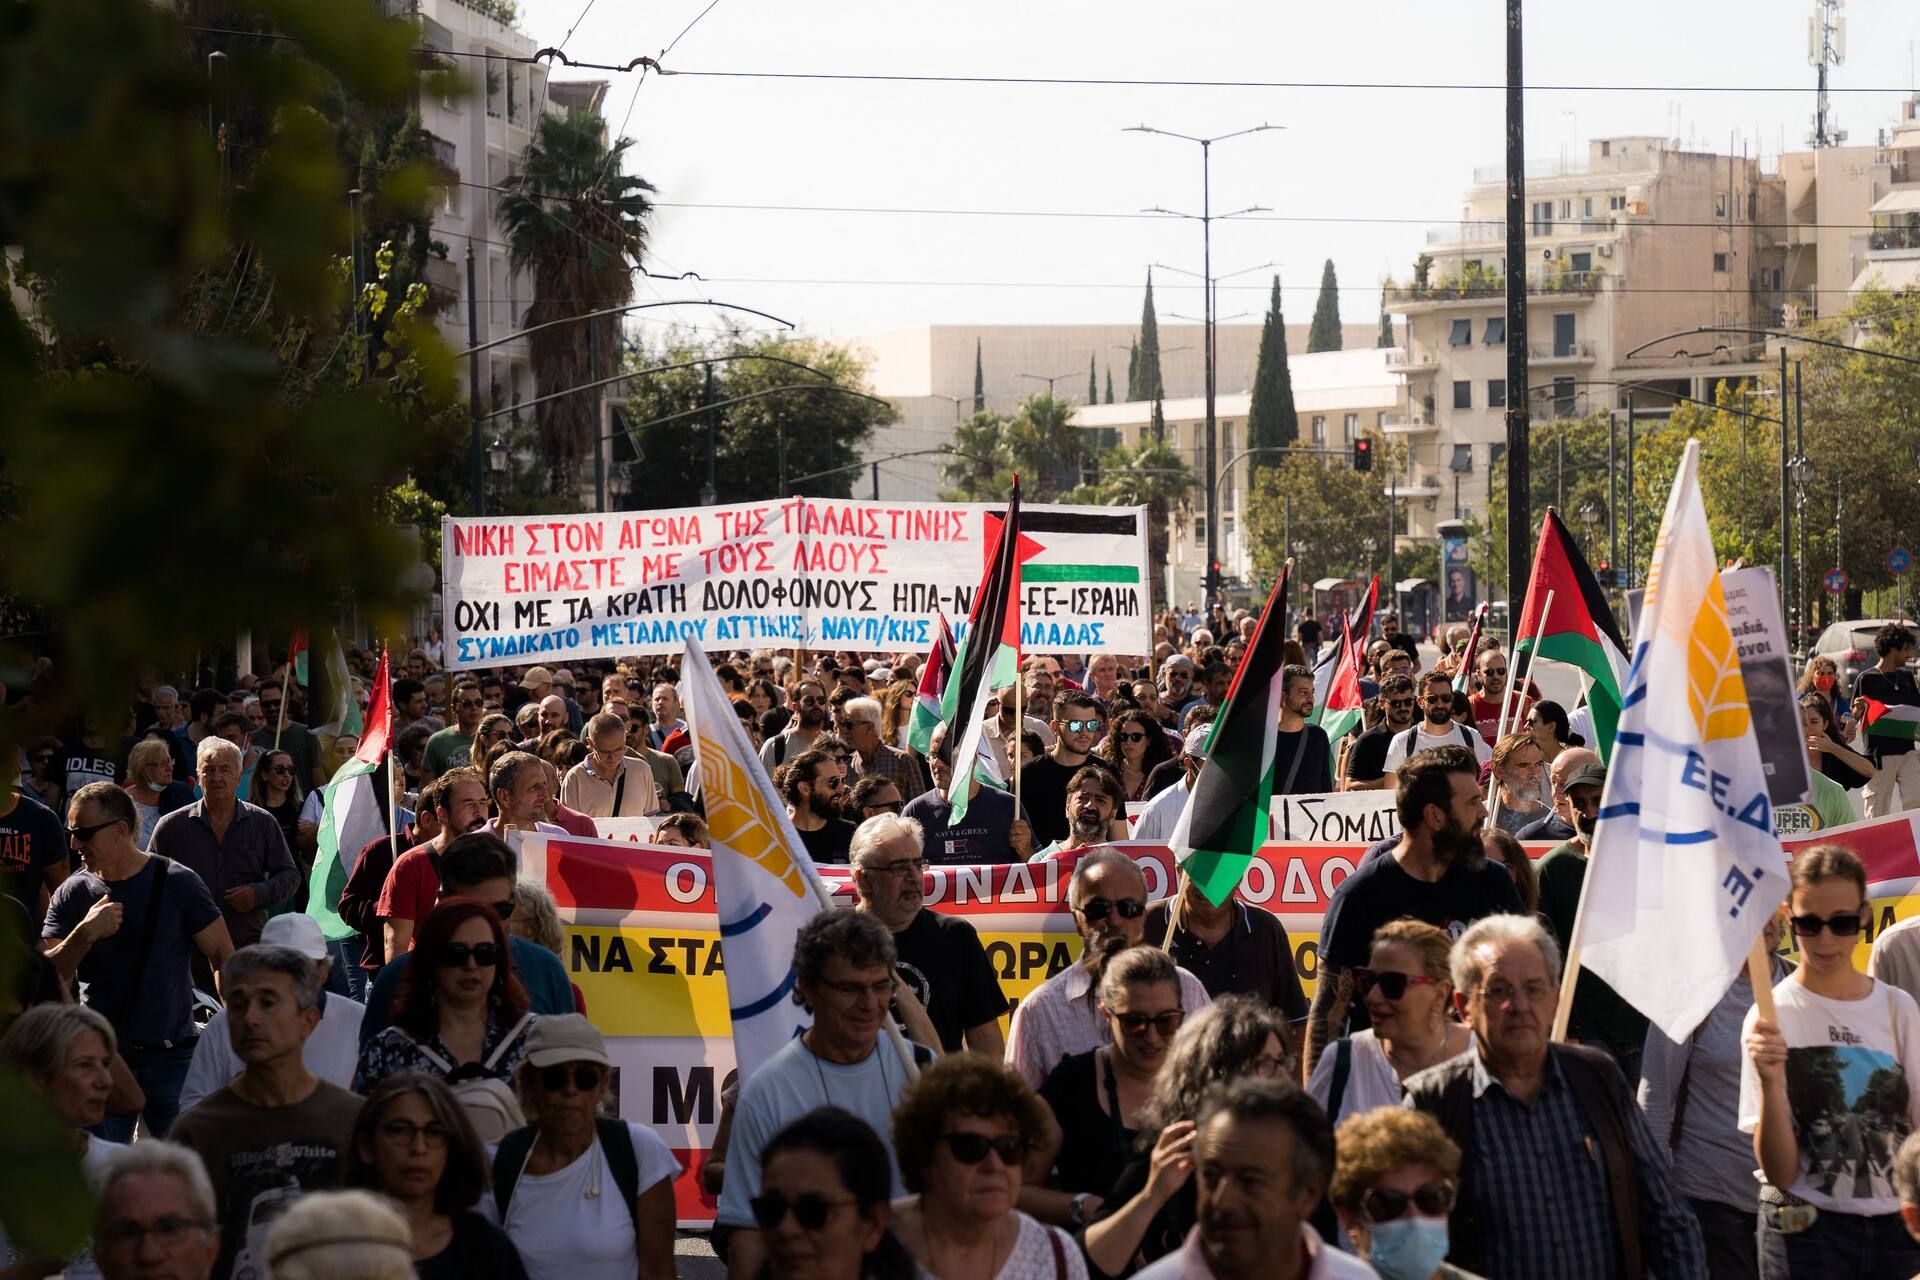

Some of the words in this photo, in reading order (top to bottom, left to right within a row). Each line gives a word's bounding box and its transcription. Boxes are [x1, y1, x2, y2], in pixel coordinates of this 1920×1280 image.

[453, 524, 515, 557] ΝΙΚΗ
[524, 521, 604, 556] ΣΤΟΝ
[618, 515, 702, 550] ΑΓΩΝΑ
[715, 507, 769, 541] ΤΗΣ
[781, 501, 969, 542] ΠΑΛΑΙΣΤΙΝΗΣ
[504, 556, 625, 594] ΕΙΜΑΣΤΕ
[642, 552, 683, 585] ΜΕ
[699, 541, 775, 575] ΤΟΥΣ
[793, 541, 888, 574] ΛΑΟΥΣ
[454, 599, 499, 632] ΟΧΙ
[514, 599, 552, 629] ΜΕ
[562, 596, 593, 624] ΤΑ
[607, 583, 687, 618] ΚΡΑΤΗ
[702, 578, 878, 612] ΔΟΛΟΦΟΝΟΥΣ
[893, 584, 1139, 617] ΗΠΑ-Ν-ΕΕ-ΙΣΡΑΗΛ
[457, 628, 580, 662] ΣΥΝΔΙΚΑΤΟ
[592, 618, 707, 647] ΜΕΤΑΛΛΟΥ
[822, 616, 930, 647] ΝΑΥΠ/ΚΗΣ
[1021, 622, 1106, 645] ΛΛΑΔΑΣ
[66, 757, 116, 776] IDLES
[0, 833, 31, 864] ALE
[571, 934, 634, 972] ΝΑ
